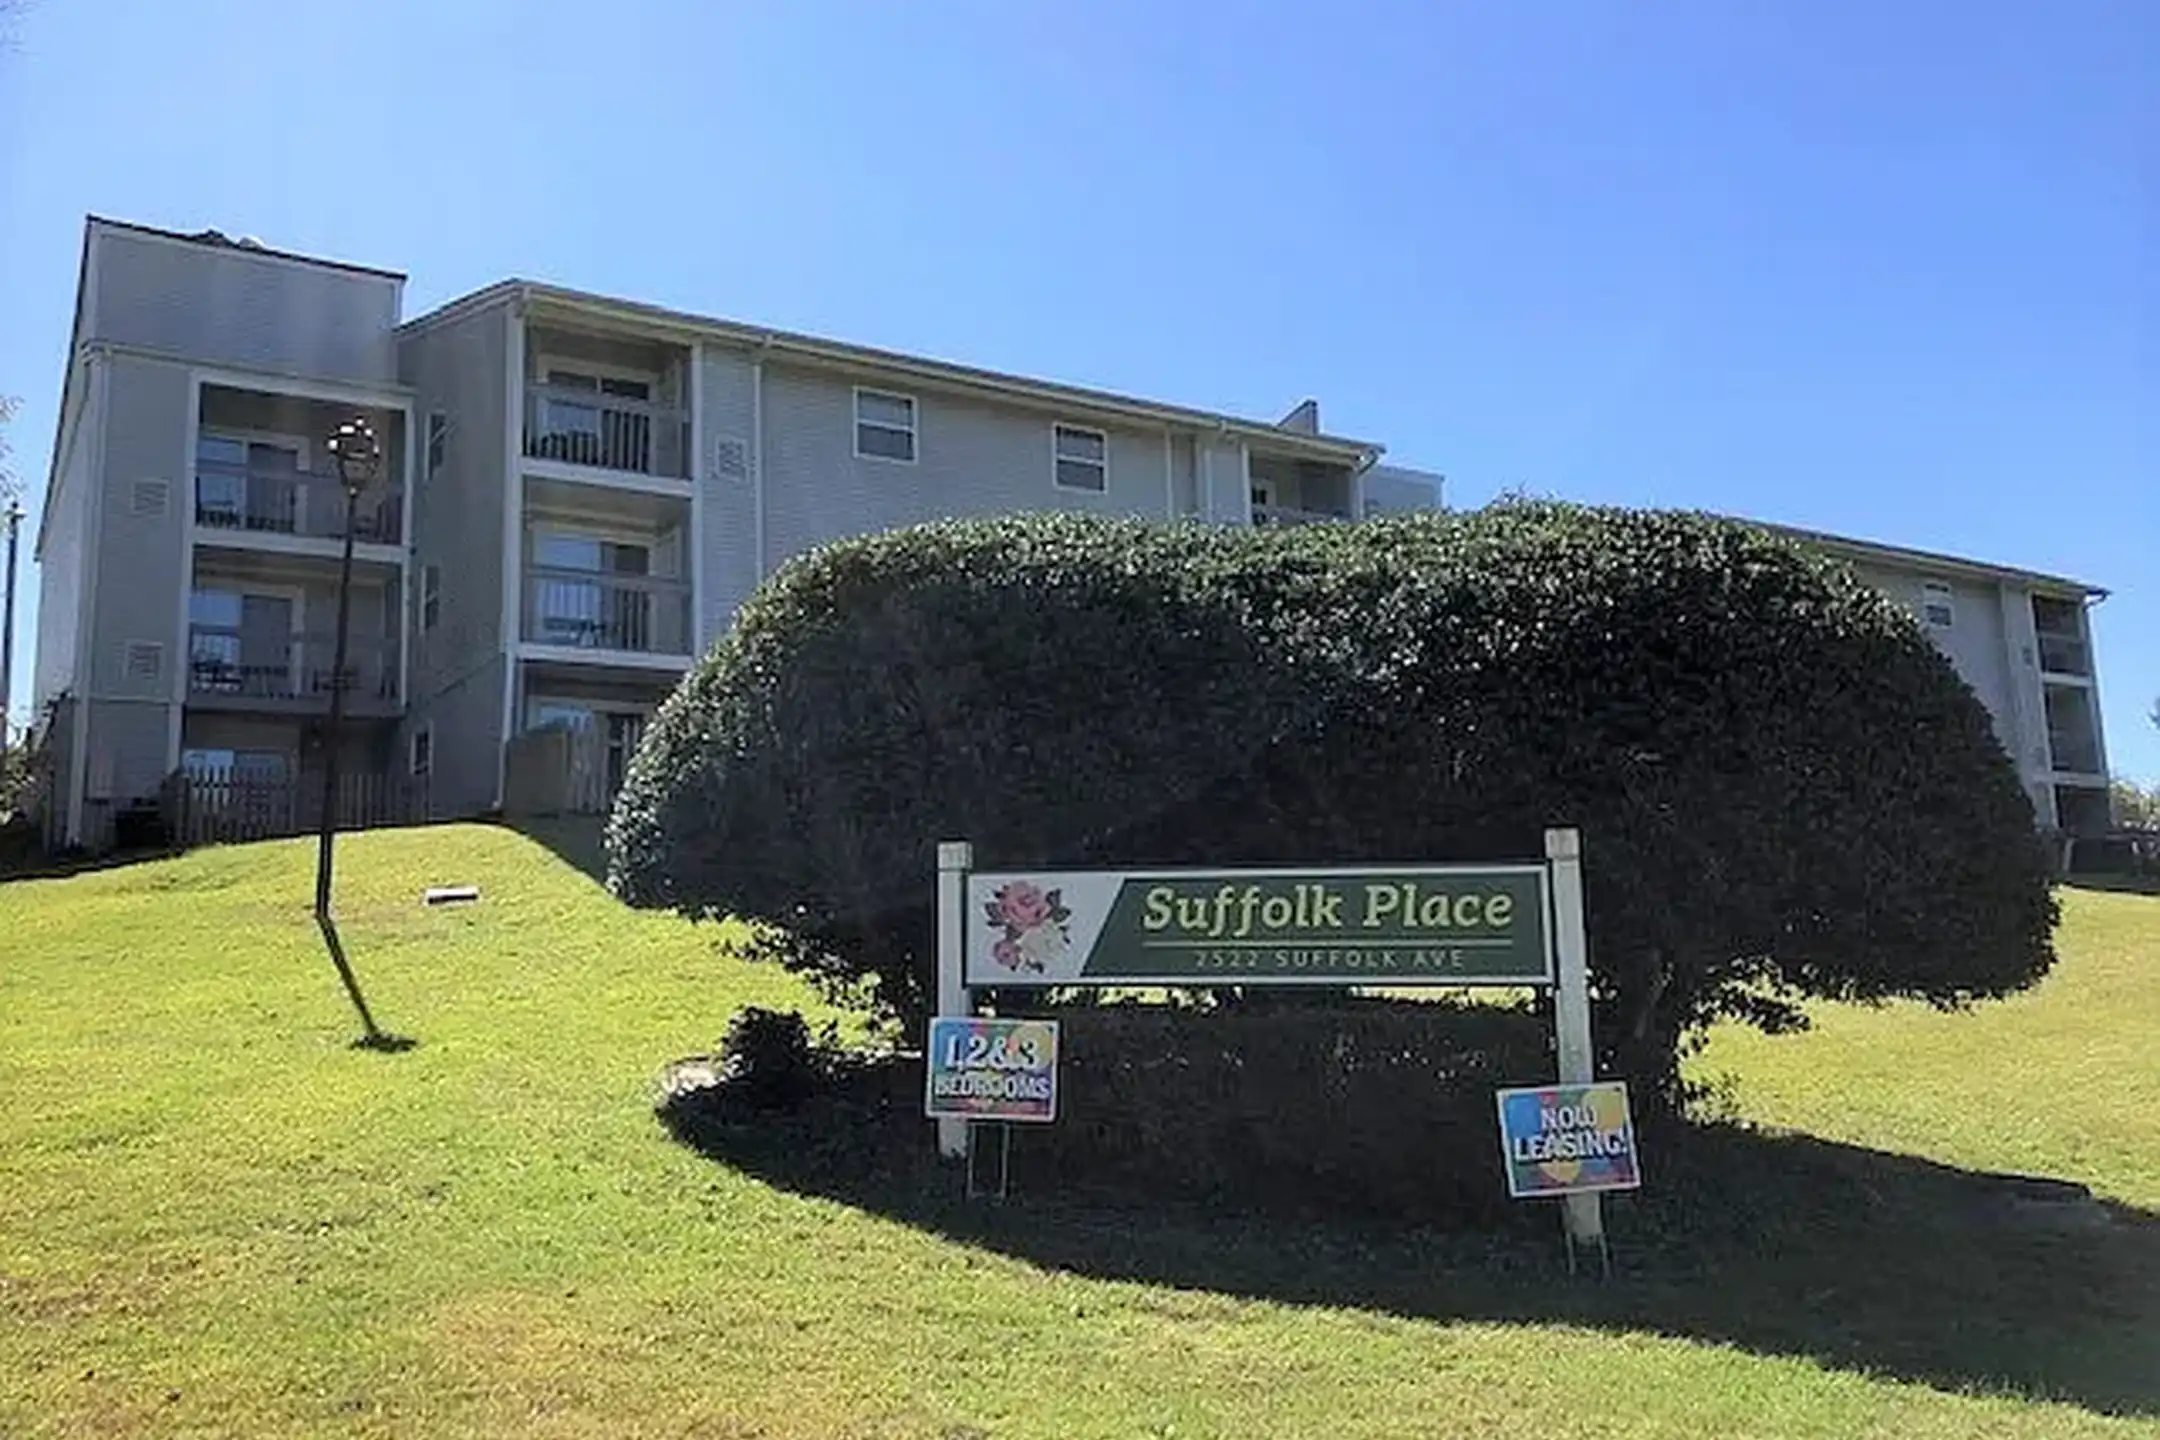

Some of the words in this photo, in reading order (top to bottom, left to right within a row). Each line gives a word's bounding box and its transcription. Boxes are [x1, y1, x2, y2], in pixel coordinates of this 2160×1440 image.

[1143, 884, 1343, 937] Suffolk
[1363, 883, 1513, 928] Place
[1275, 949, 1397, 968] SUFFOLK
[1413, 949, 1464, 968] AVE
[935, 1072, 1050, 1099] BEDROOMS
[1540, 1104, 1598, 1129] NOW
[1514, 1127, 1628, 1161] LEASING!
